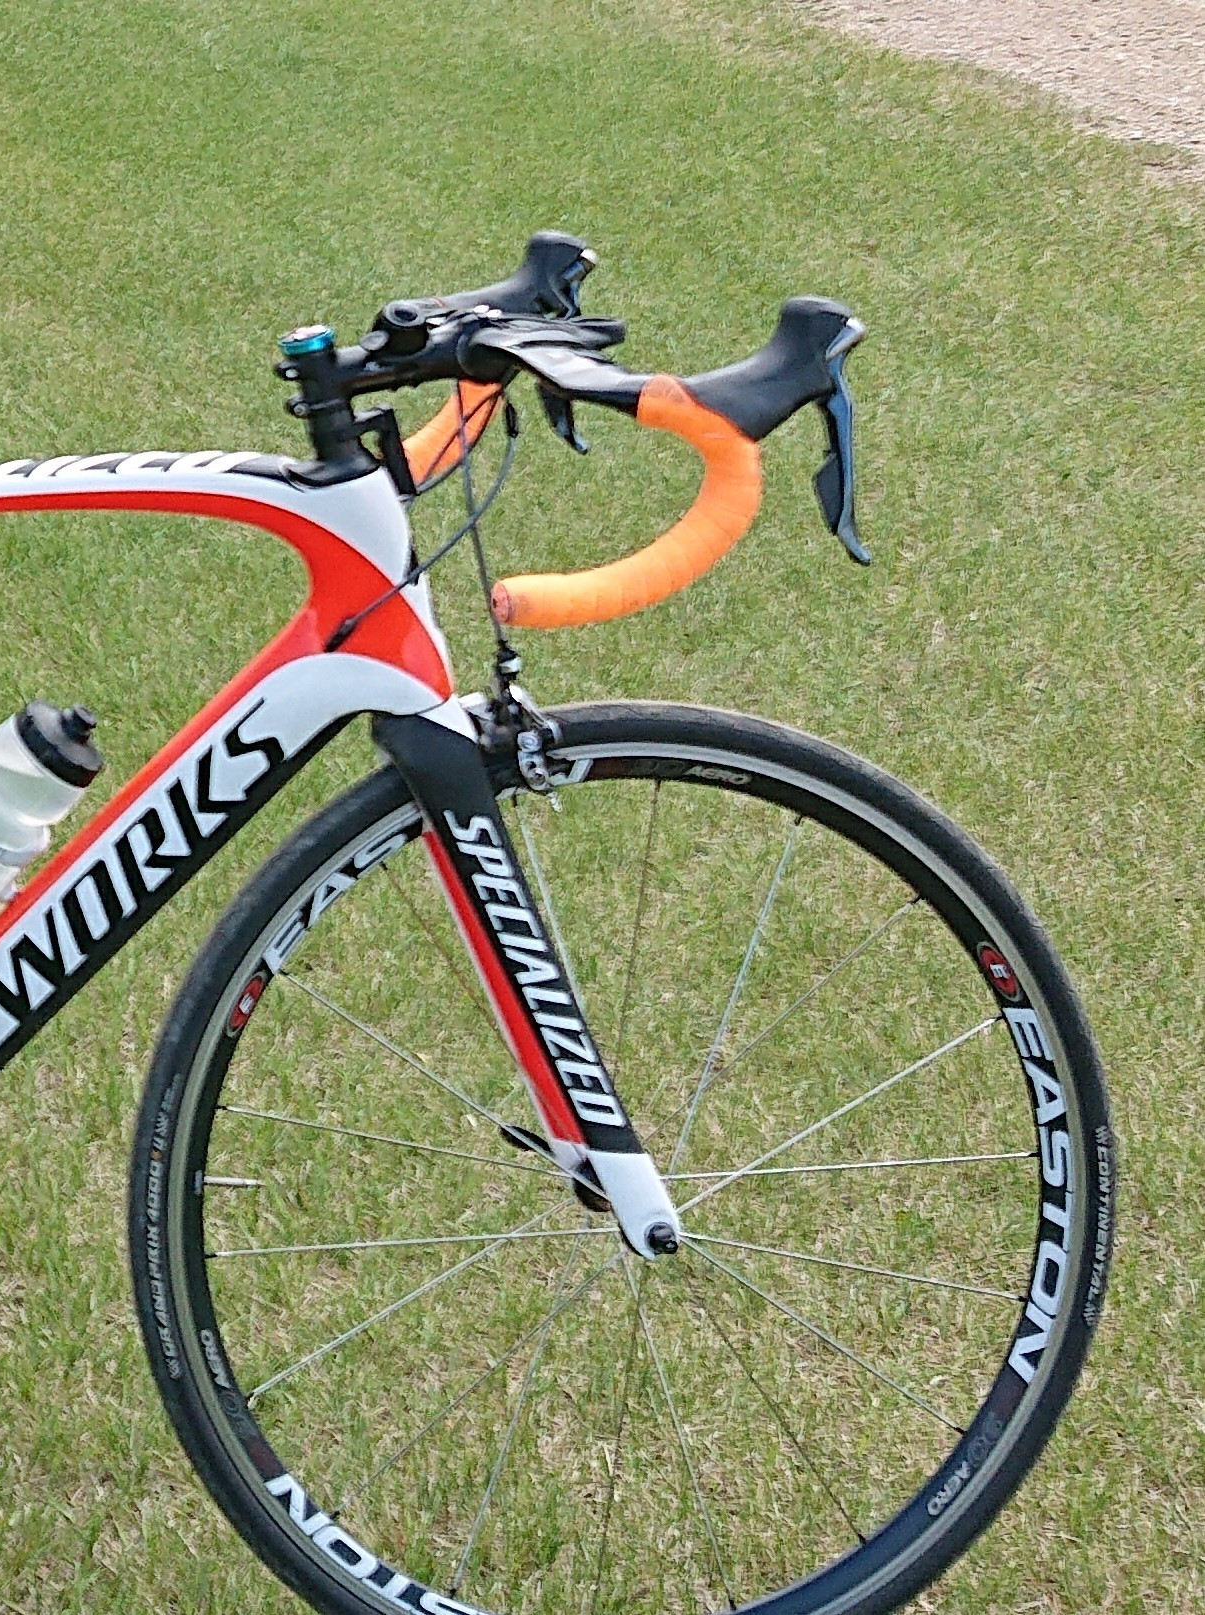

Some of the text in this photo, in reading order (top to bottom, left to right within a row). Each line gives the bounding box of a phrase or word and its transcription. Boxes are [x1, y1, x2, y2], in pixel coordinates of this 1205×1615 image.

[682, 764, 752, 785] AERO
[444, 810, 628, 1128] SPECIALIZED
[147, 1159, 164, 1224] 4000
[1002, 1006, 1074, 1387] EASTON
[1089, 1142, 1112, 1300] CONTINENTAL
[147, 1224, 163, 1280] PRIX
[150, 1279, 179, 1357] GRAND
[200, 1328, 232, 1389] AERO
